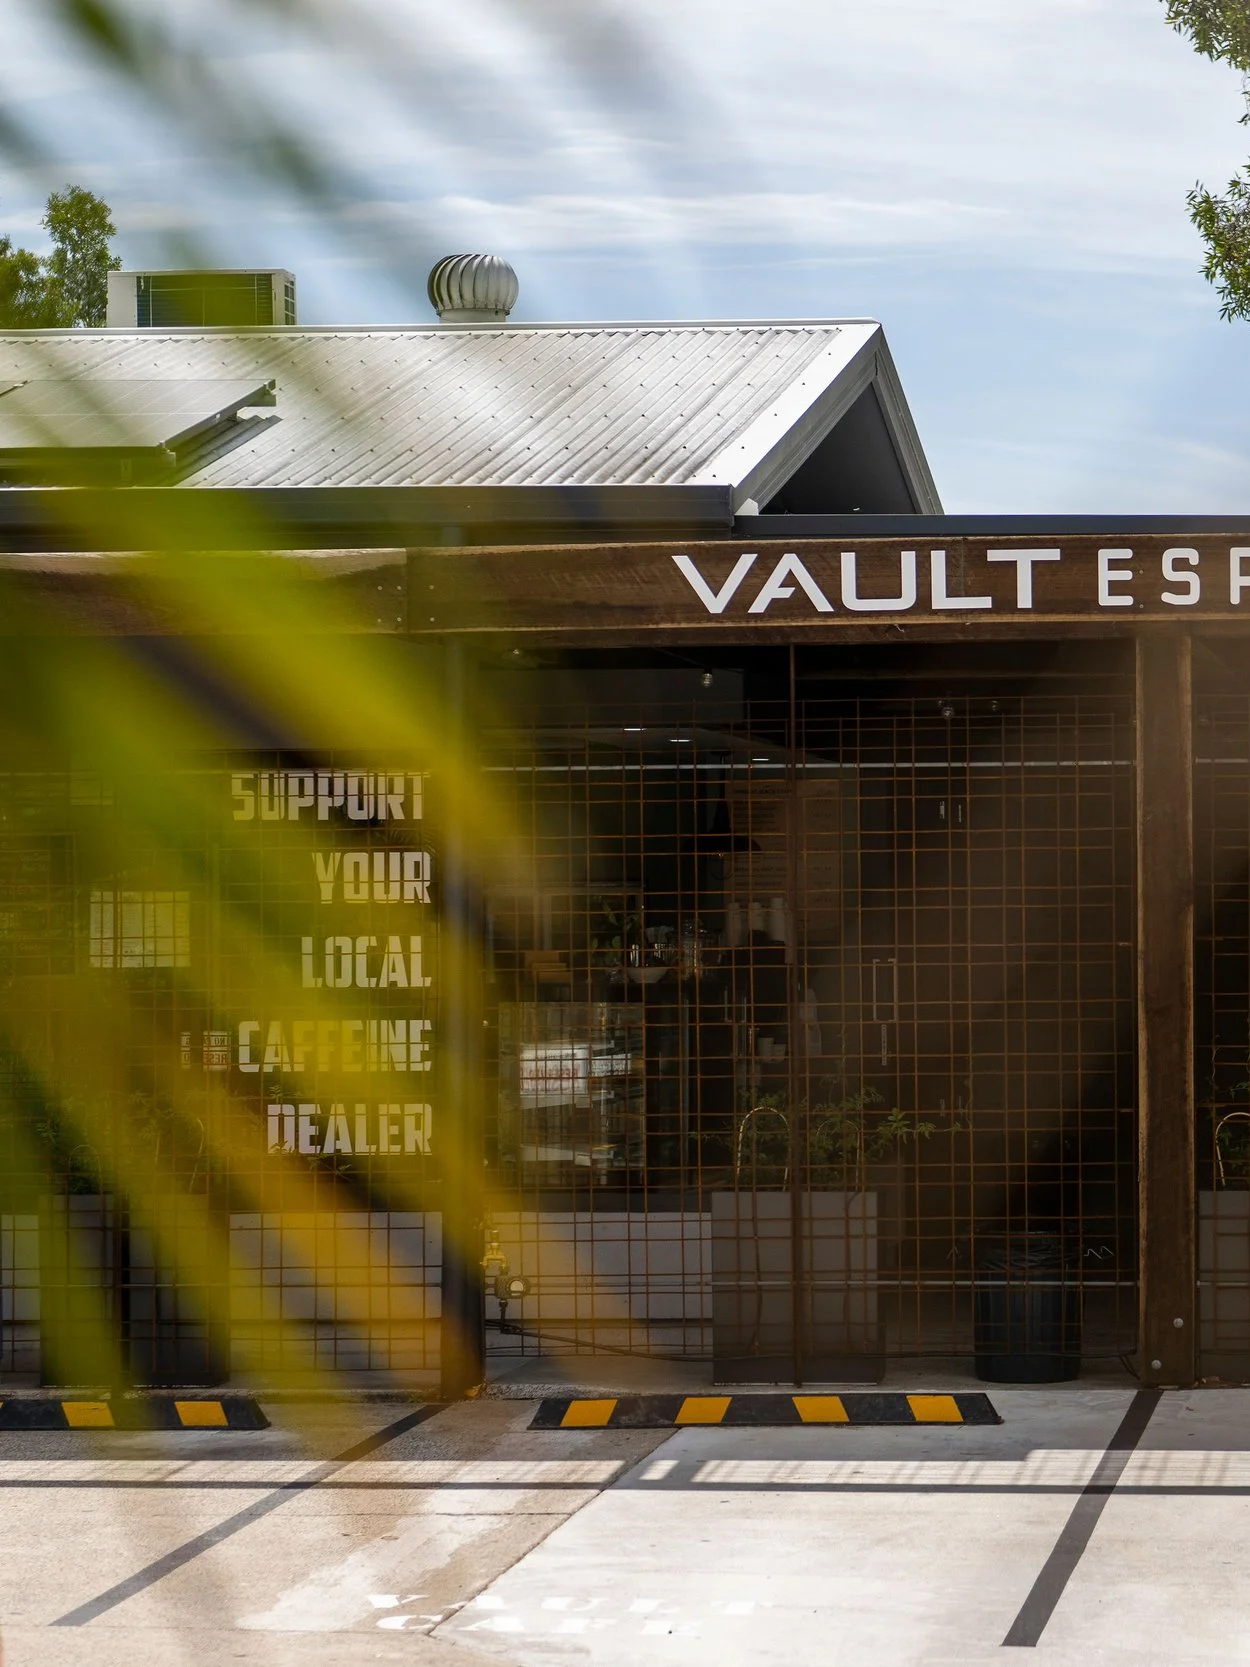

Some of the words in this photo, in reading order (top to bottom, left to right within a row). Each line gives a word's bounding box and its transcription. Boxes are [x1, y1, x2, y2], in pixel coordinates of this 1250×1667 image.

[672, 549, 1061, 613] VAULT
[231, 772, 431, 820] SUPPORT
[312, 852, 431, 904] YOUR
[301, 935, 432, 988] LOCAL
[238, 1019, 432, 1072] CAFFEINE
[267, 1103, 432, 1156] DEALER
[366, 1594, 777, 1615] VAULT
[376, 1615, 704, 1636] CAFE
